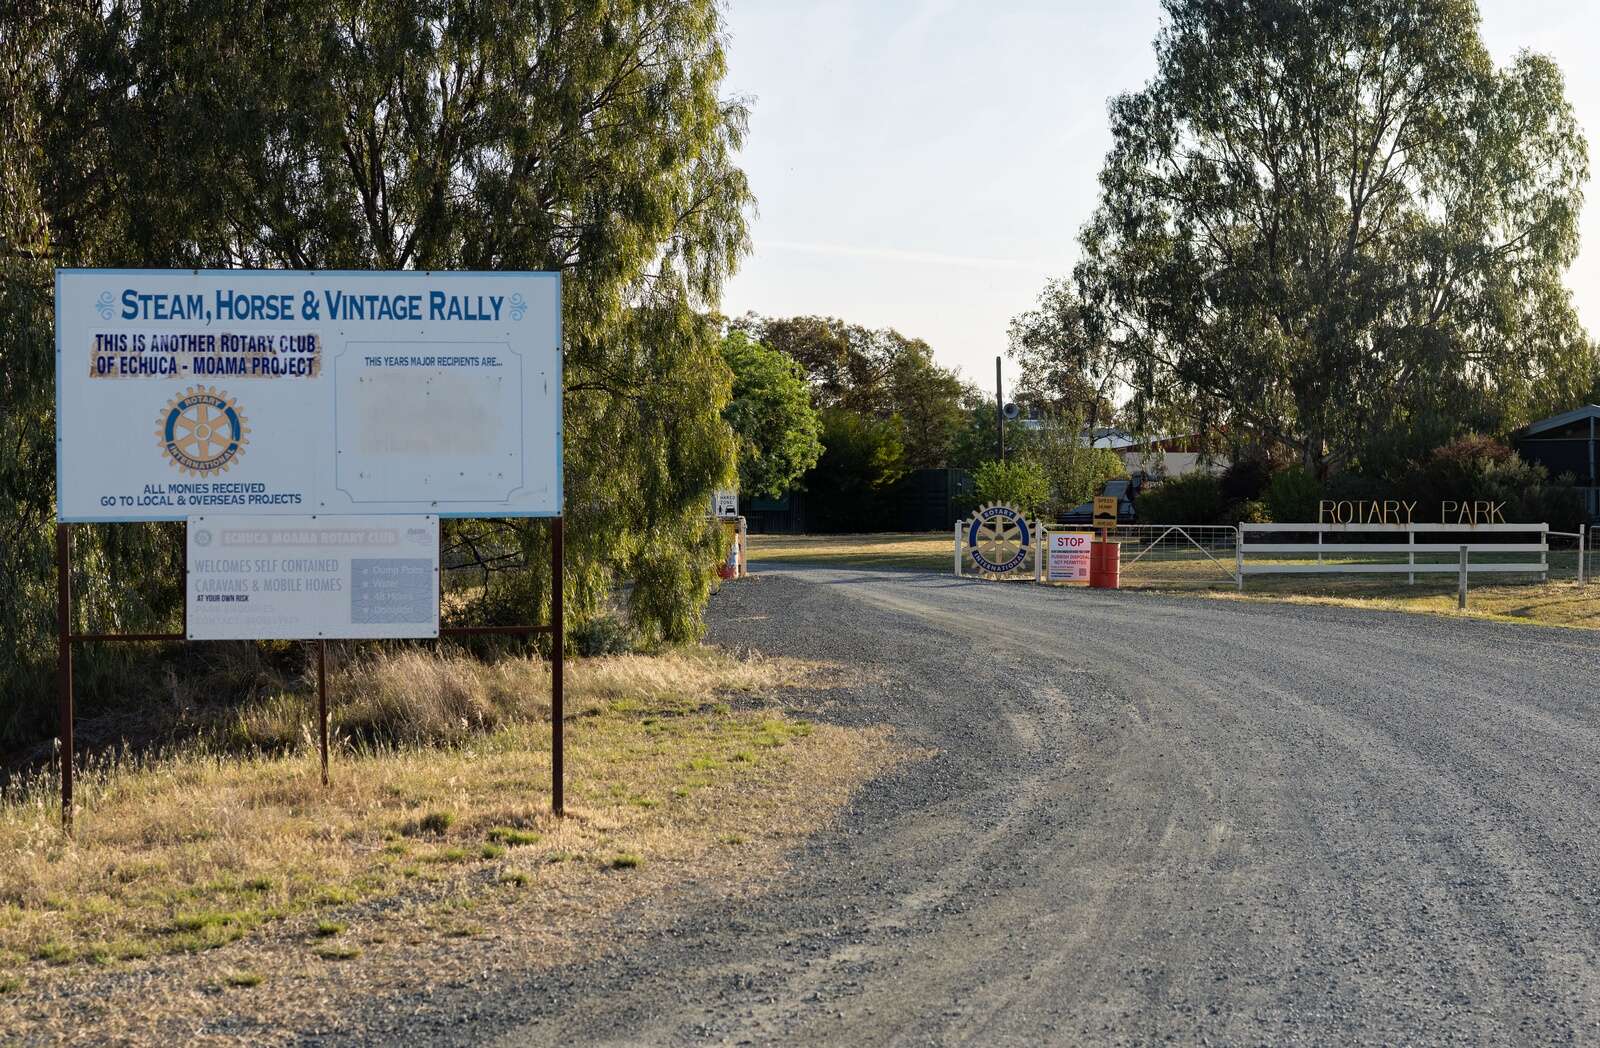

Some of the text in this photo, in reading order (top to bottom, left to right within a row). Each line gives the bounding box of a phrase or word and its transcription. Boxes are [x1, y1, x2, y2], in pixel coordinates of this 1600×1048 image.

[121, 289, 504, 326] STEAM, HORSE & VINTAGE RALLY
[96, 334, 315, 353] THIS IS ANOTHER ROTARY CLUB
[96, 356, 115, 374] OF
[120, 356, 178, 375] ECHUCA
[193, 357, 247, 375] MOAMA
[252, 357, 314, 375] PROJECT
[364, 356, 503, 367] THIS YEARS MAJOR RECIPIENTS ARE...
[184, 395, 221, 407] ROTARY
[169, 444, 236, 470] INTERNATIONAL
[144, 483, 265, 494] ALL MONIES RECEIVED
[100, 494, 302, 506] GO TO LOCAL & OVERSEAS PROJECTS
[983, 508, 1014, 518] ROTARY
[1319, 499, 1506, 524] ROTARY PARK
[224, 532, 268, 544] ECHUCA
[271, 532, 318, 544] MOAMA
[321, 532, 364, 544] ROTARY
[1057, 537, 1084, 547] STOP
[195, 559, 339, 573] WELCOMES SELF CONTAINED
[974, 552, 1024, 572] INTERNATIONAL
[195, 578, 343, 592] CARAVANS & MOBILE HOMES
[196, 594, 249, 602] AT YOUR OWN RISK
